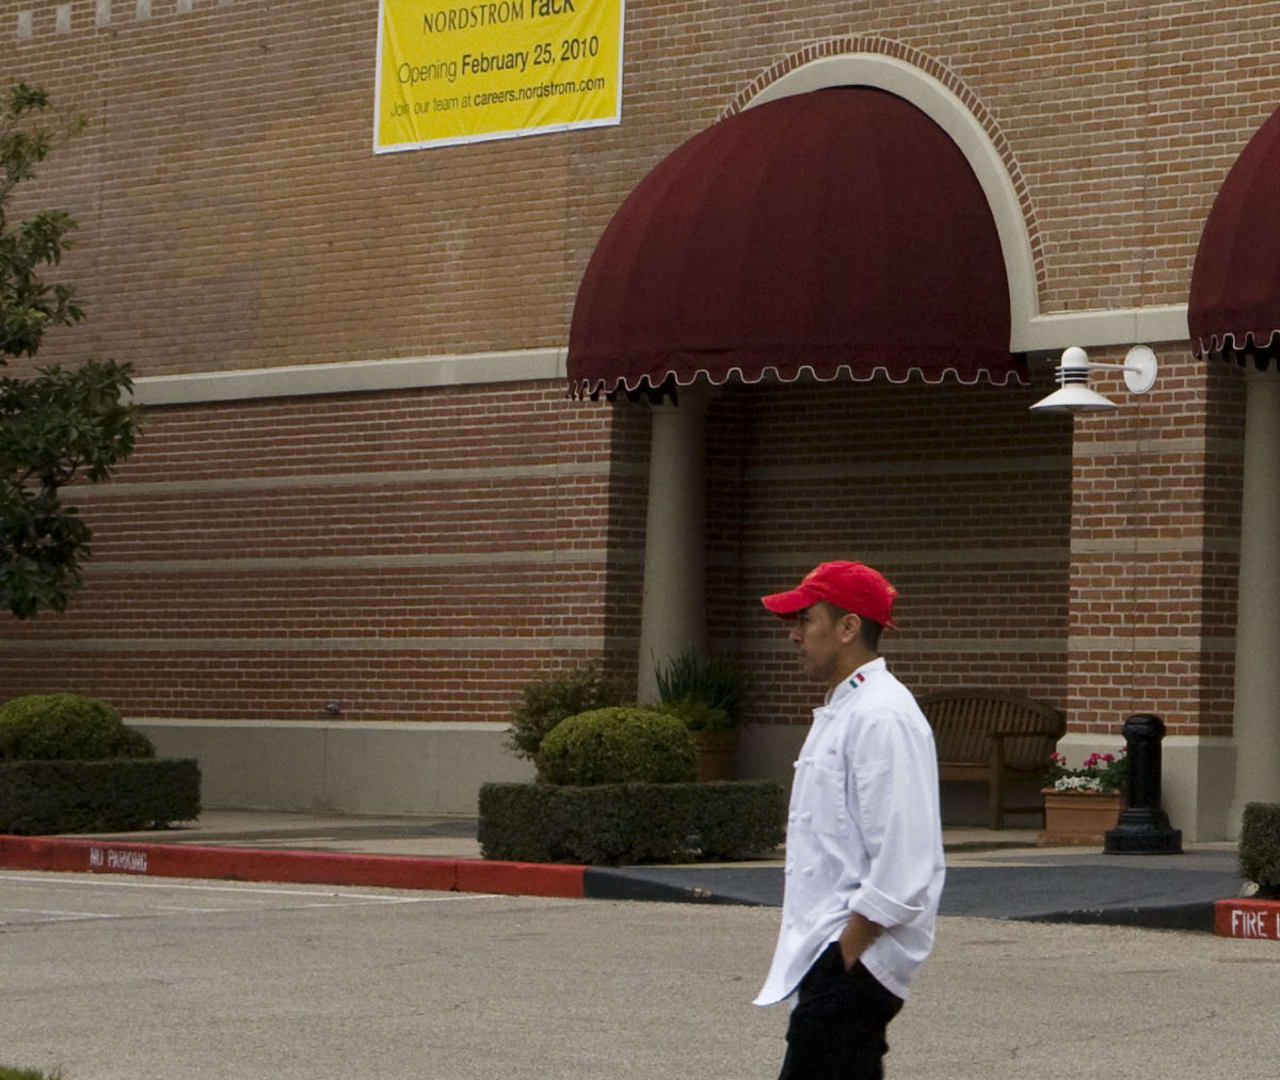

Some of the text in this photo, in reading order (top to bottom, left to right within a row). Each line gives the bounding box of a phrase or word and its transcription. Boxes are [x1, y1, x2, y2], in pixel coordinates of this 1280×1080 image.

[423, 1, 525, 35] NORDSTROM
[399, 35, 599, 87] Opening February 25, 2010
[414, 101, 430, 114] our
[433, 97, 459, 112] team
[461, 93, 471, 108] at
[473, 77, 605, 106] careers.nordstrom.com
[107, 849, 147, 872] PARKING
[1232, 910, 1268, 937] FIRE
